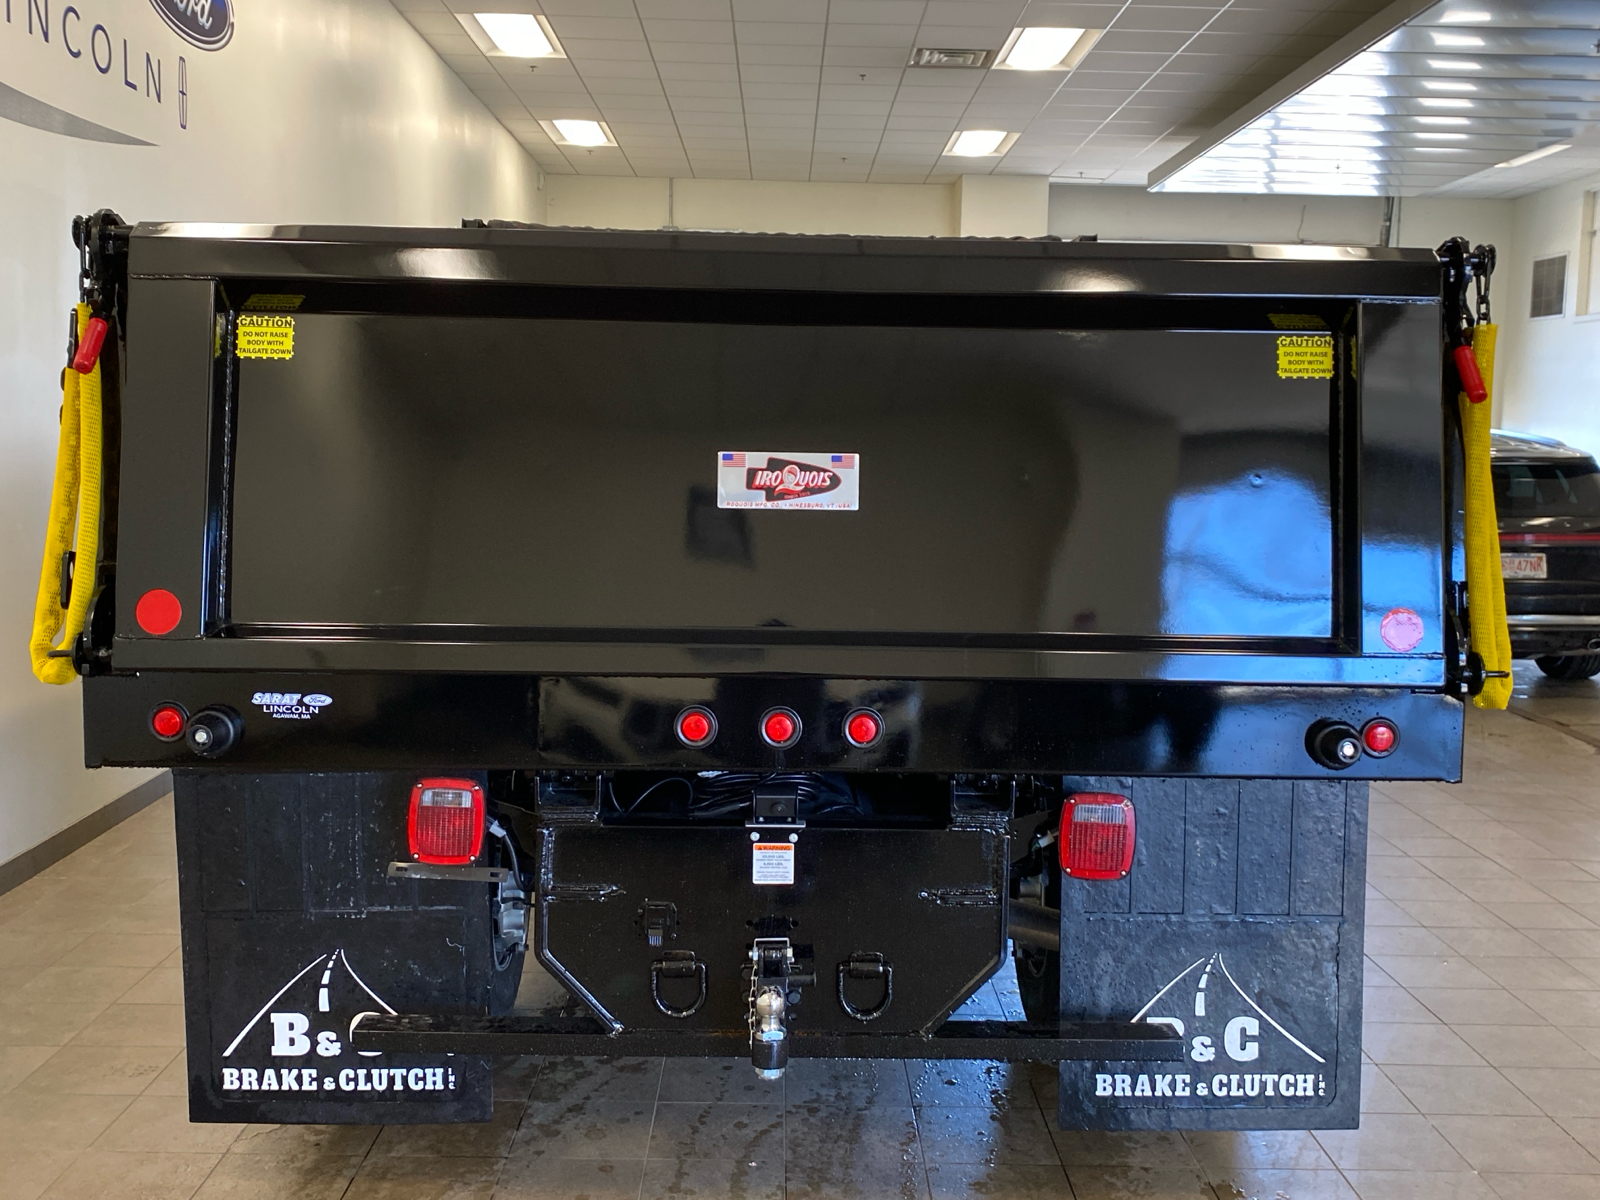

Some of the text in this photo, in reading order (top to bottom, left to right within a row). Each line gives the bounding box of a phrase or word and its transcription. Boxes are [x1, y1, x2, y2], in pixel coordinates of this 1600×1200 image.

[240, 318, 292, 328] CAUTION
[1280, 338, 1332, 347] CAUTION
[753, 465, 834, 492] IROQUOIS
[252, 692, 302, 705] SARAT
[263, 705, 319, 714] LINCOLN
[270, 1012, 312, 1057] B
[316, 1031, 342, 1057] &
[1190, 1036, 1216, 1062] &
[1224, 1016, 1259, 1062] C
[222, 1068, 318, 1091] BRAKE
[323, 1076, 336, 1091] &
[338, 1067, 444, 1092] CLUTCH
[1095, 1074, 1191, 1097] BRAKE
[1196, 1082, 1208, 1096] &
[1212, 1074, 1314, 1097] CLUTCH
